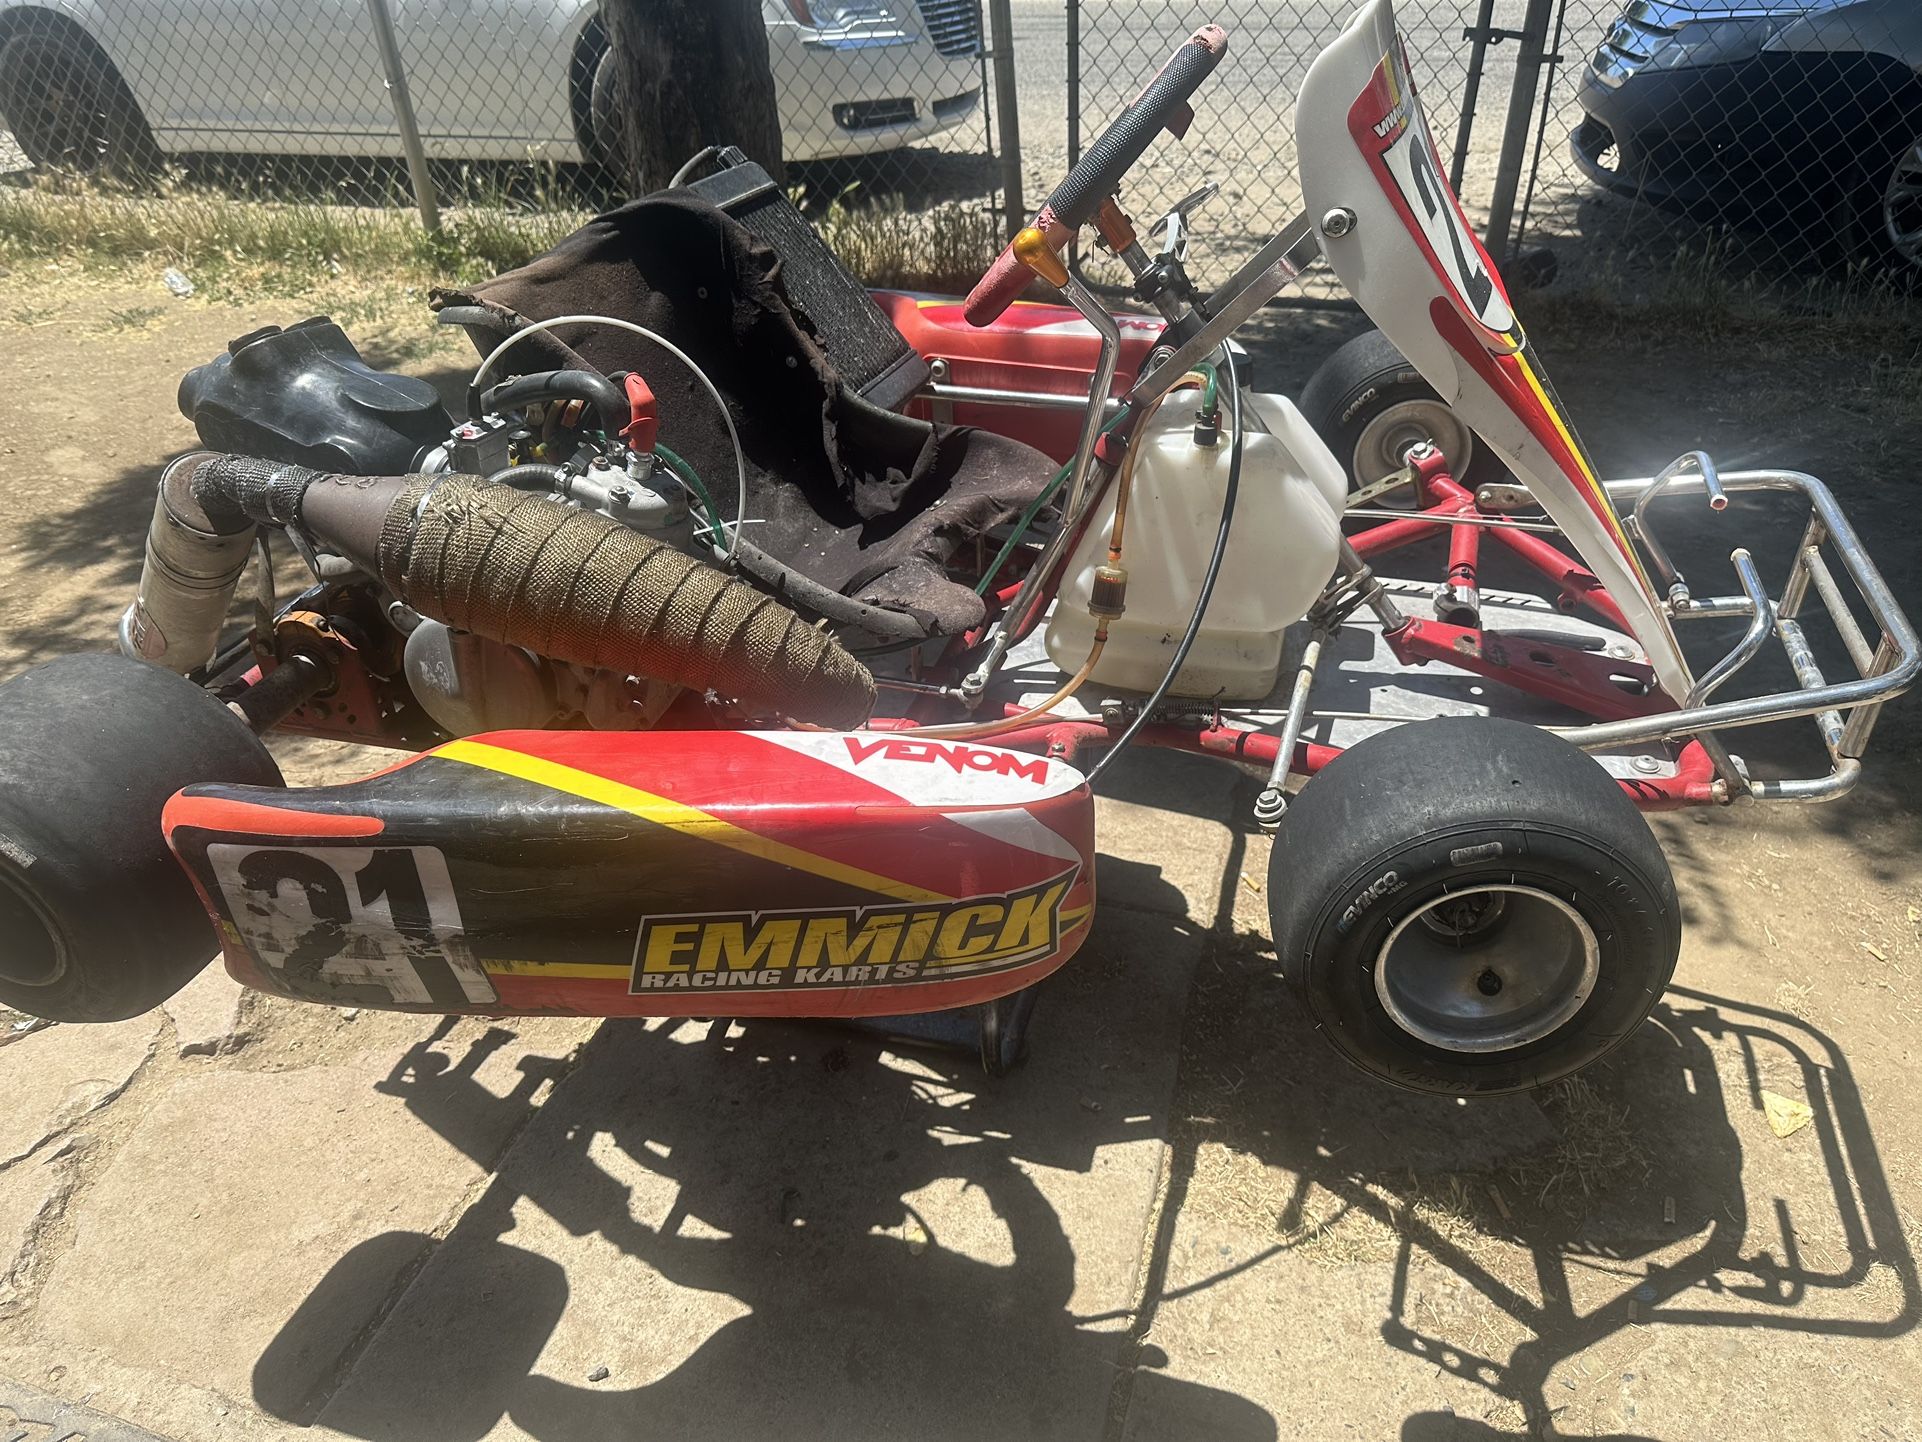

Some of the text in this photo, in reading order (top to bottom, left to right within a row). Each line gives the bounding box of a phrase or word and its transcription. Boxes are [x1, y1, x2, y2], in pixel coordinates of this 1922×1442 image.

[1342, 387, 1375, 422] EVINCO
[842, 736, 1050, 785] VENOM
[1342, 870, 1399, 925] EVINCO
[237, 849, 471, 1003] 21
[640, 962, 920, 989] RACING KARTS
